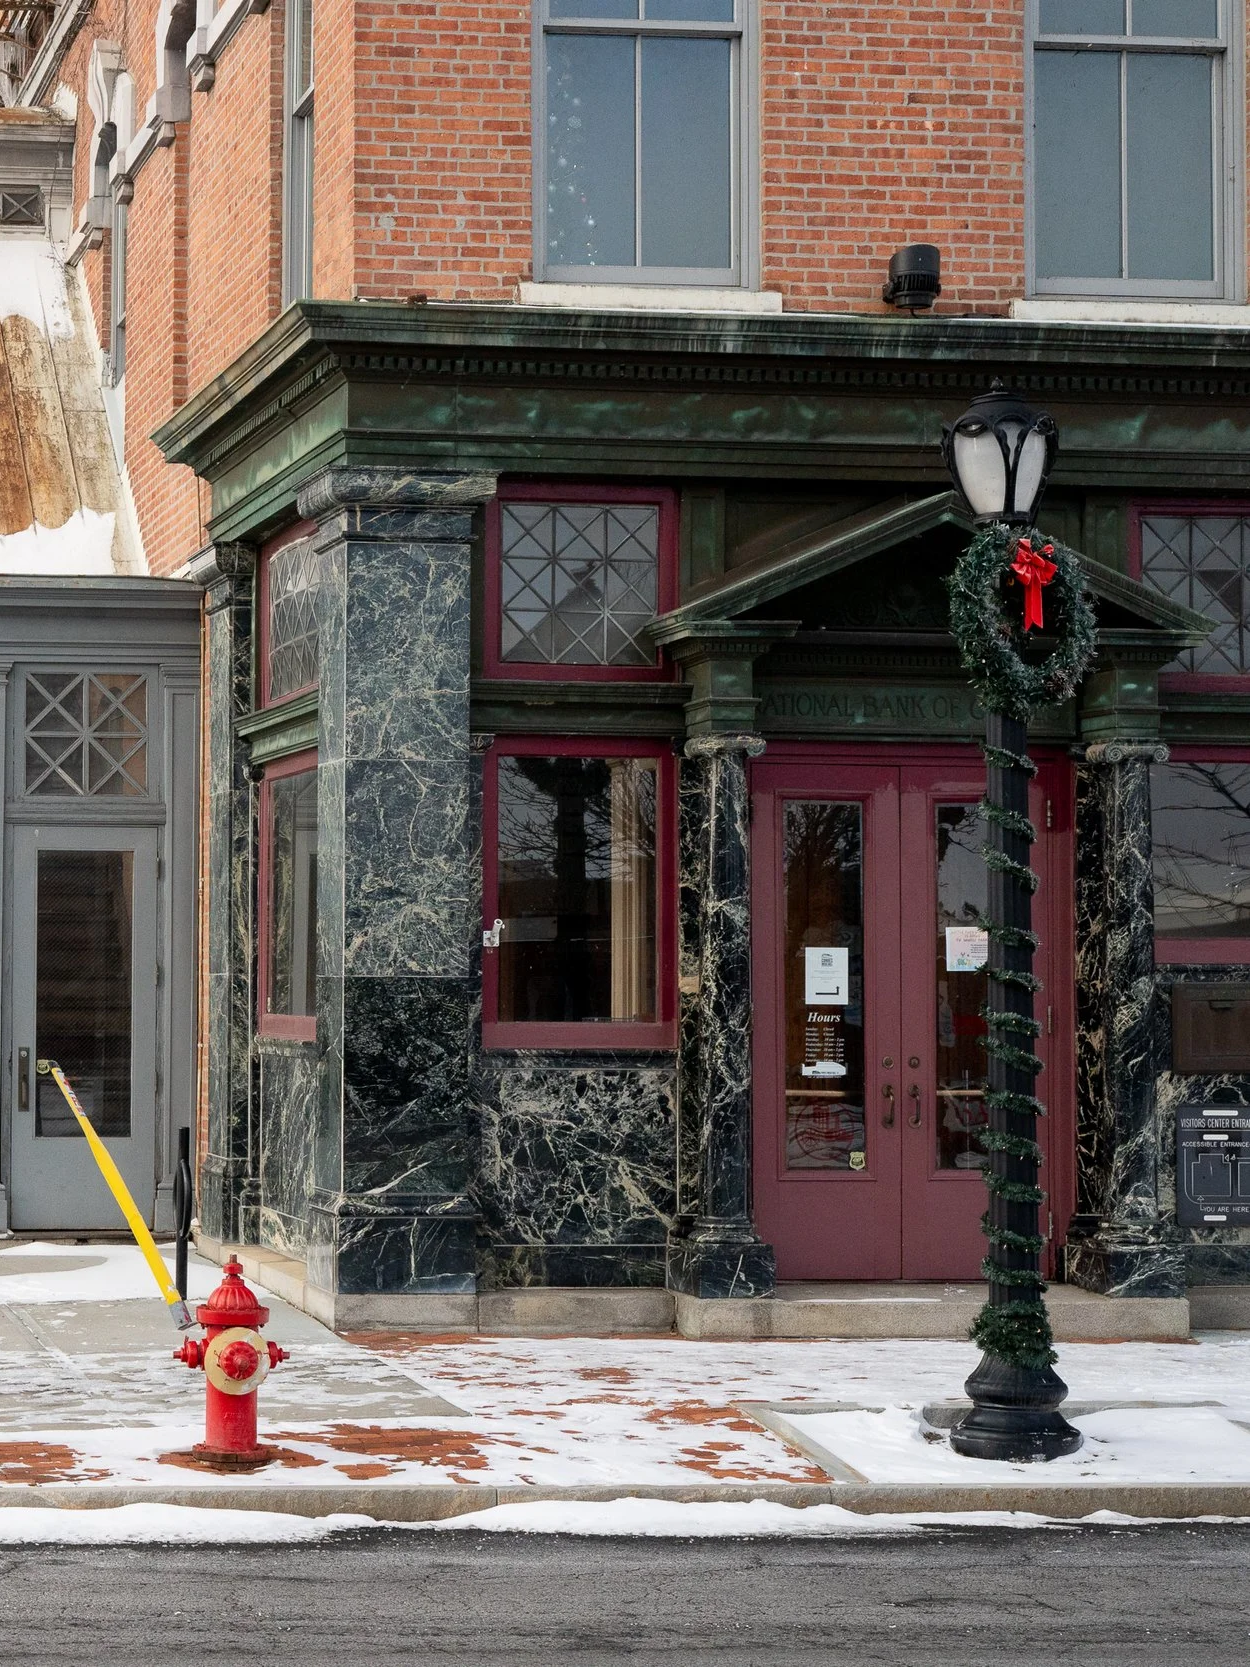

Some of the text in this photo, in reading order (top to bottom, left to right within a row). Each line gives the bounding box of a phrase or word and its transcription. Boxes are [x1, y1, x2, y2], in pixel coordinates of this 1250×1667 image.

[863, 695, 926, 718] BANK
[931, 696, 962, 719] OF
[807, 1012, 841, 1023] Hours
[1180, 1118, 1250, 1128] VISITORS CENTER ENTRA
